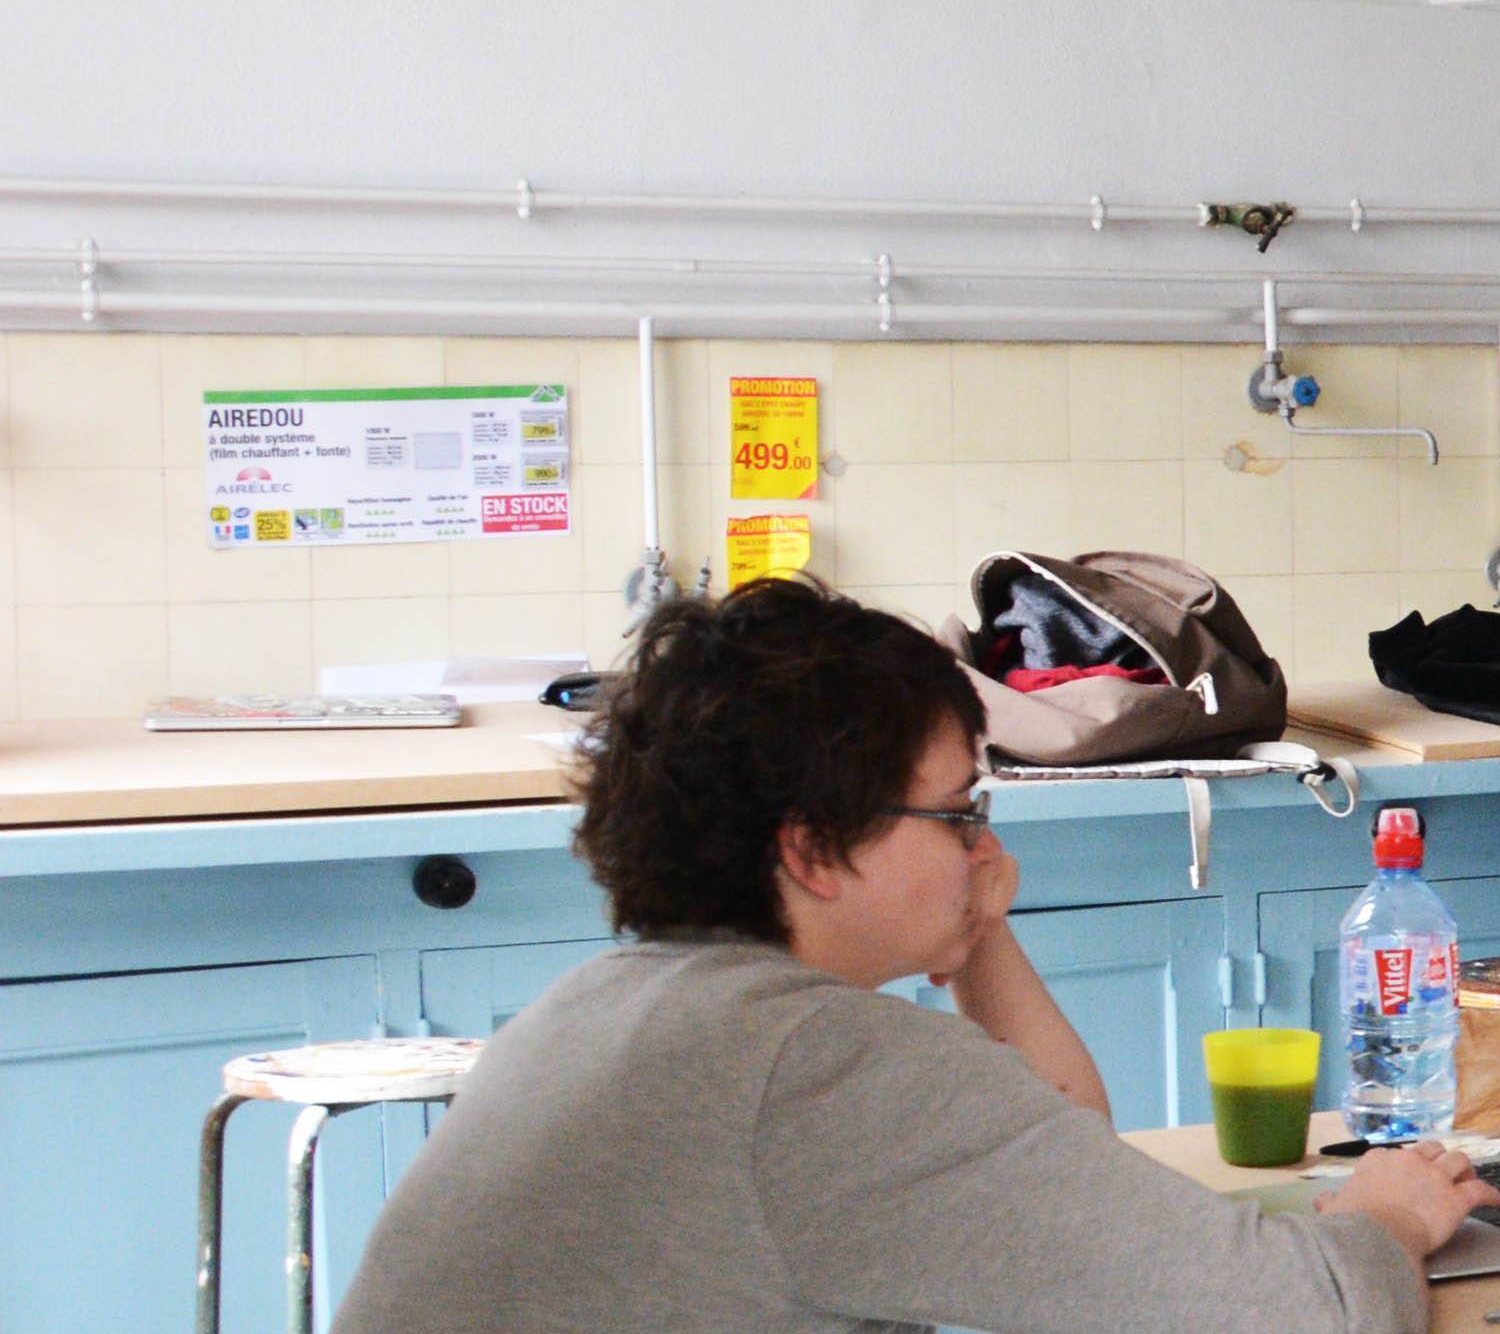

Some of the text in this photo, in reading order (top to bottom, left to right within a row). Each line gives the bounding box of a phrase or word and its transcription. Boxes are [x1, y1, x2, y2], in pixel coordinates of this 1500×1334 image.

[732, 379, 816, 396] PROMOTION
[208, 407, 304, 428] AIREDOU
[220, 432, 261, 445] double
[265, 432, 316, 448] système
[209, 448, 238, 463] (film
[241, 446, 300, 459] chauffant
[316, 445, 352, 458] fonte)
[483, 496, 568, 515] EN STOCK
[1382, 951, 1407, 1007] Vittel
